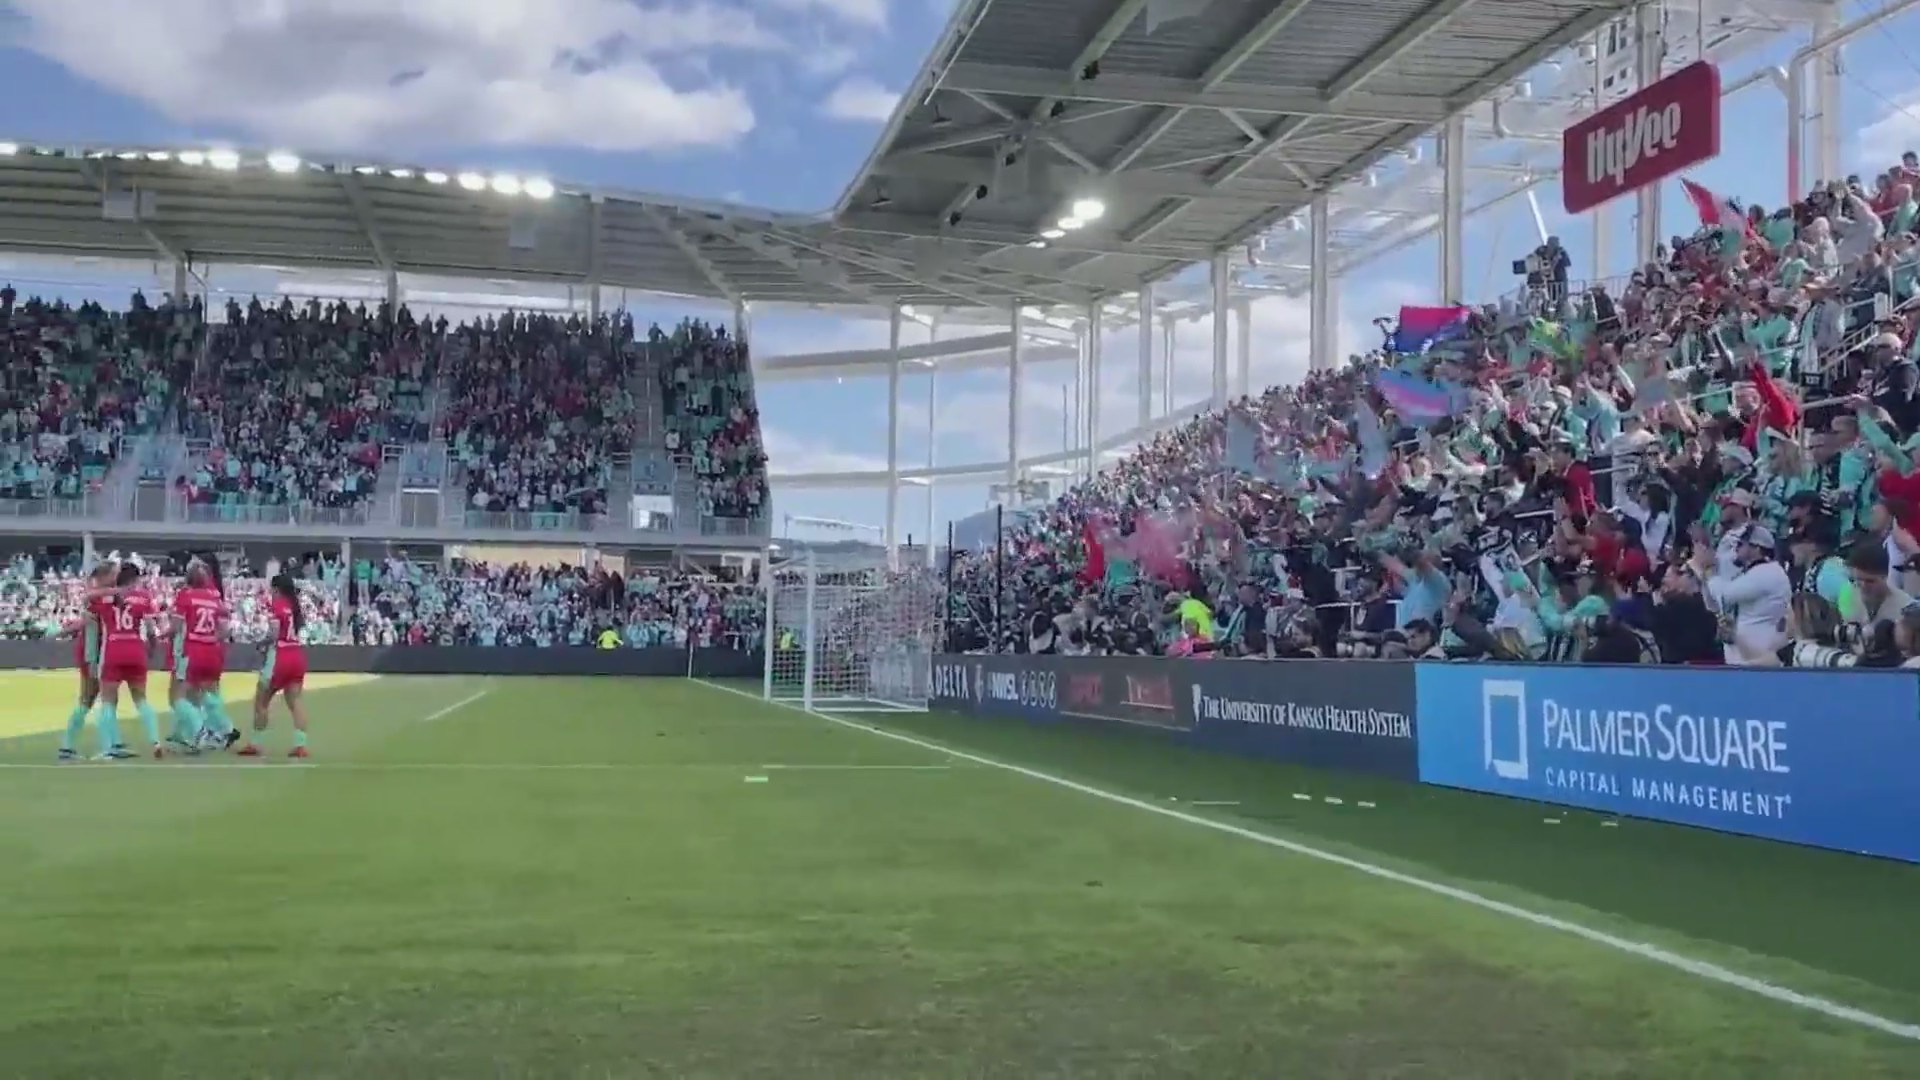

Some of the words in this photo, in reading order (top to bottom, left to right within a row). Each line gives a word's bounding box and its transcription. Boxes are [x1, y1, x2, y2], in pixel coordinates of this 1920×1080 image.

[1587, 102, 1681, 186] HyVee
[112, 604, 133, 630] 16
[194, 607, 215, 633] 25
[935, 664, 969, 699] DELTA
[1203, 696, 1220, 719] THE
[1221, 698, 1272, 725] UNIVERSITY
[1273, 703, 1288, 725] OF
[1288, 703, 1324, 730] KANSAS
[1325, 705, 1366, 735] HEALTH
[1367, 708, 1411, 739] SYSTEM
[1545, 766, 1620, 797] CAPITAL
